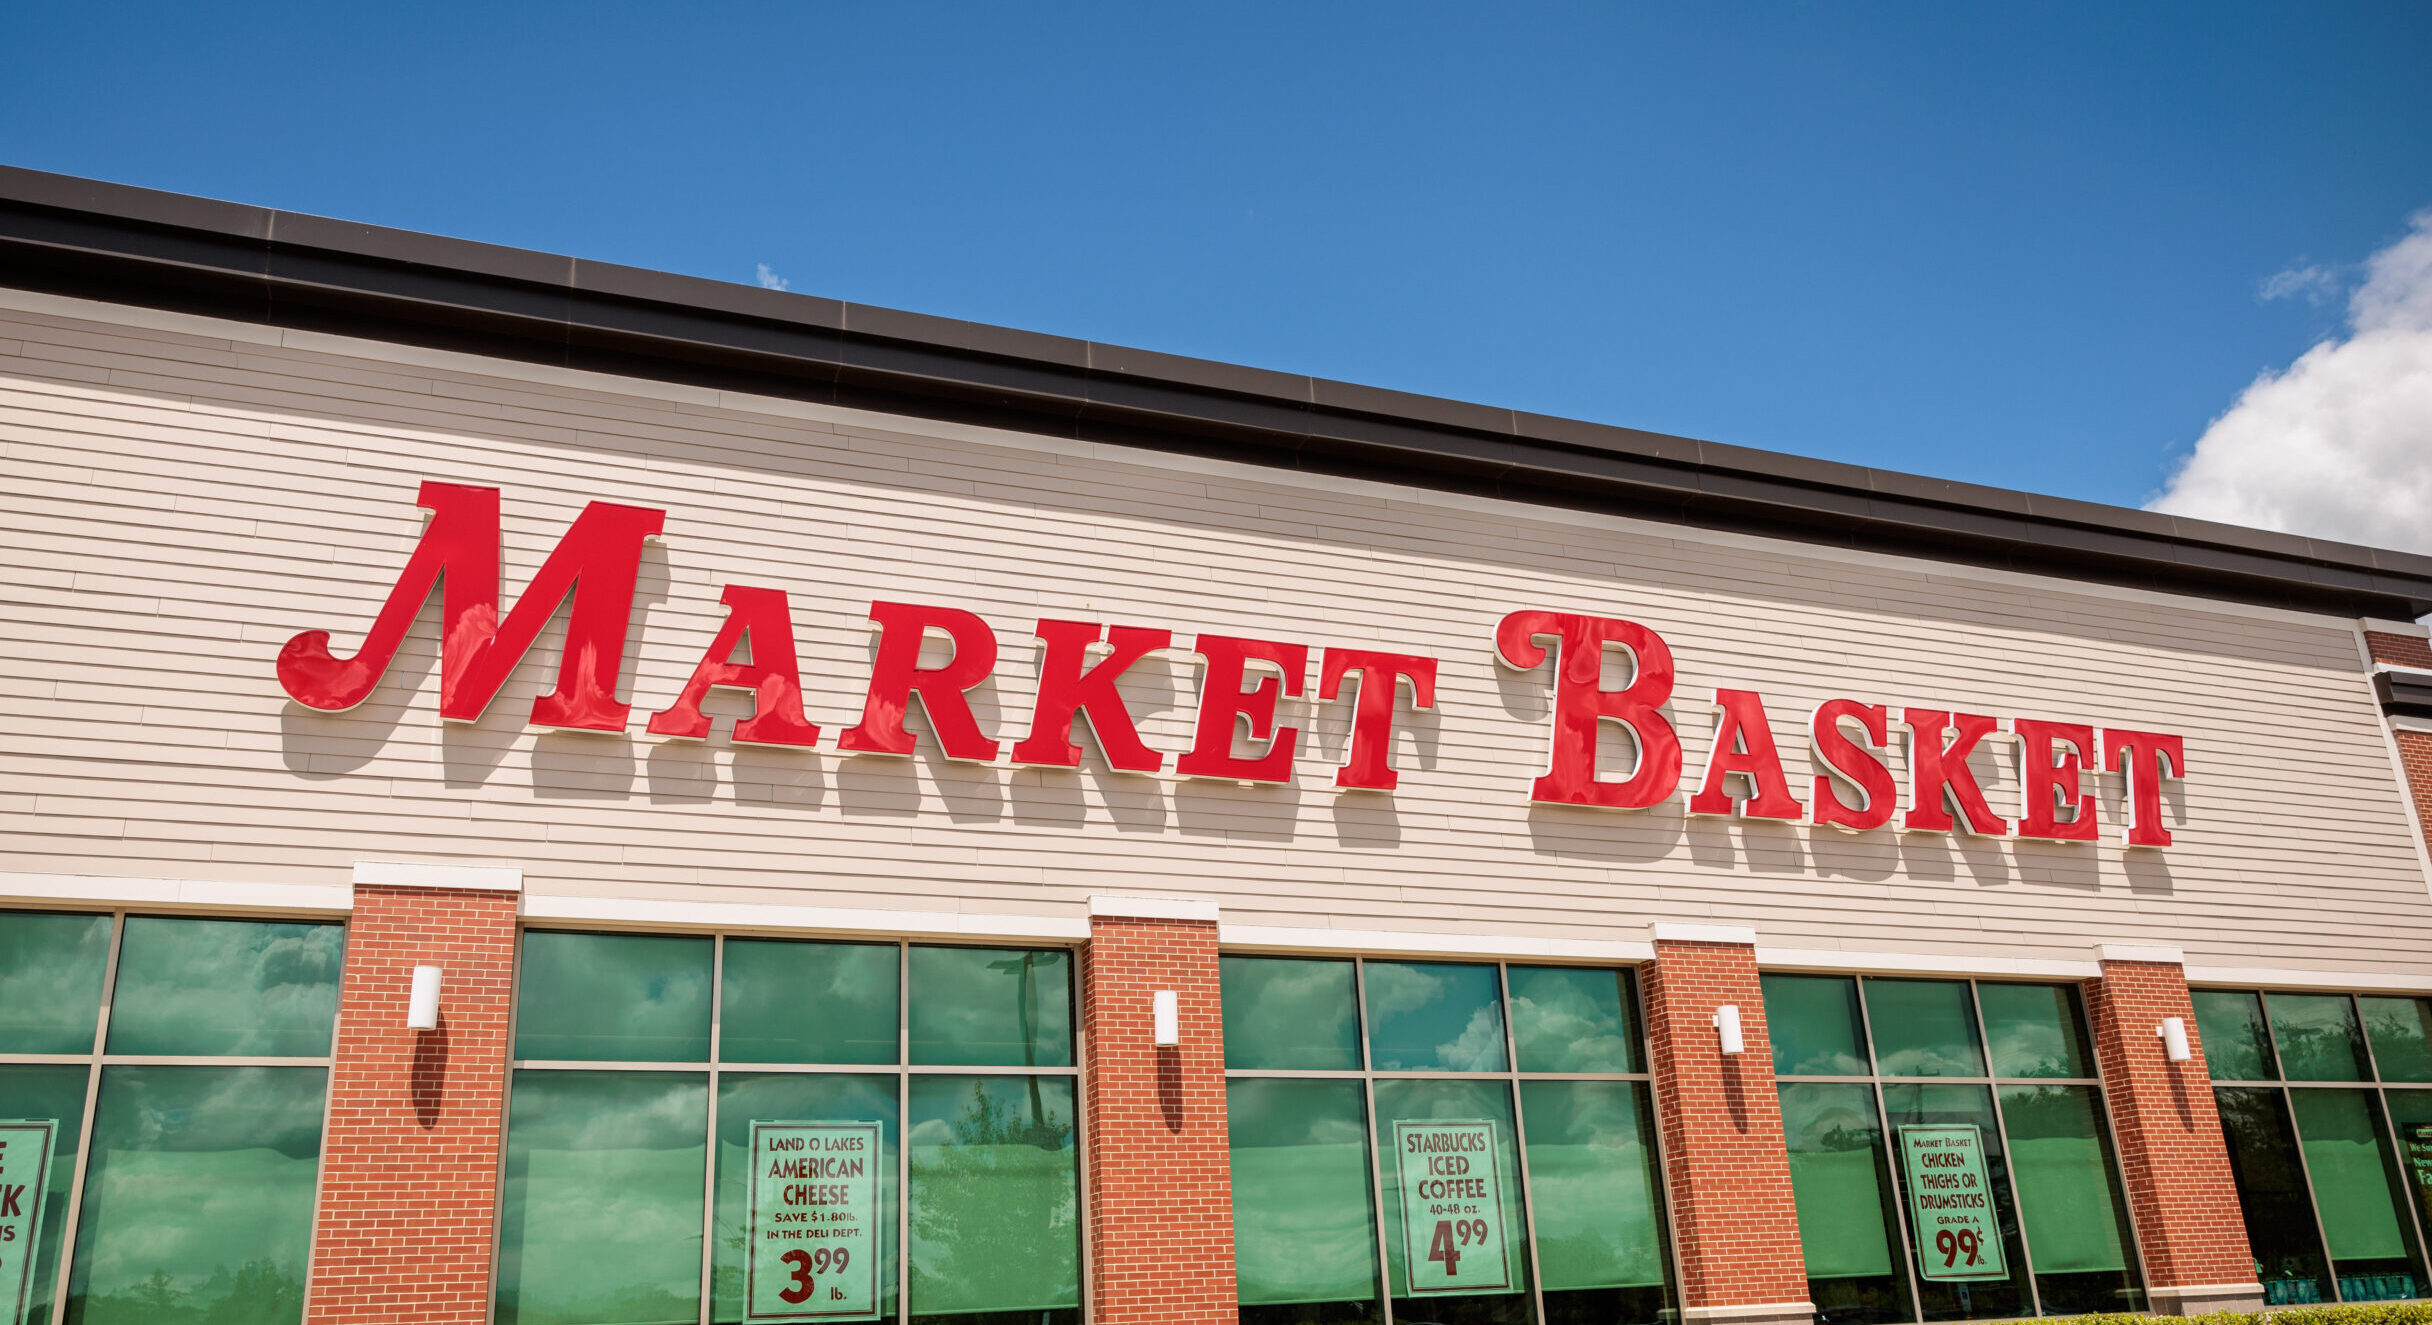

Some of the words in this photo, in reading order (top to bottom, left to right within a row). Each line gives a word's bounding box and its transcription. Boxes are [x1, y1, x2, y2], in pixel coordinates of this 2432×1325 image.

[276, 480, 1439, 792] MARKET
[1494, 609, 2186, 849] BASKET
[769, 1137, 805, 1152] LAND
[809, 1137, 820, 1151] O
[825, 1137, 864, 1151] LAKES
[1406, 1132, 1486, 1153] STARBUCKS
[1913, 1138, 1943, 1148] MARKET
[1945, 1137, 1972, 1148] BASKET
[768, 1157, 864, 1179] AMERICAN
[1428, 1156, 1470, 1176] ICED
[1921, 1152, 1966, 1168] CHICKEN
[1418, 1178, 1487, 1200] COFFEE
[1920, 1174, 1960, 1190] THIGHS
[1961, 1173, 1978, 1189] OR
[783, 1184, 849, 1206] CHEESE
[1919, 1193, 1985, 1210] DRUMSTICKS
[774, 1212, 808, 1223] SAVE
[1429, 1203, 1461, 1216] 40-48
[1936, 1215, 1970, 1225] GRADE
[1972, 1215, 1980, 1224] A
[766, 1229, 779, 1240] IN
[781, 1228, 803, 1239] THE
[805, 1228, 829, 1239] DELI
